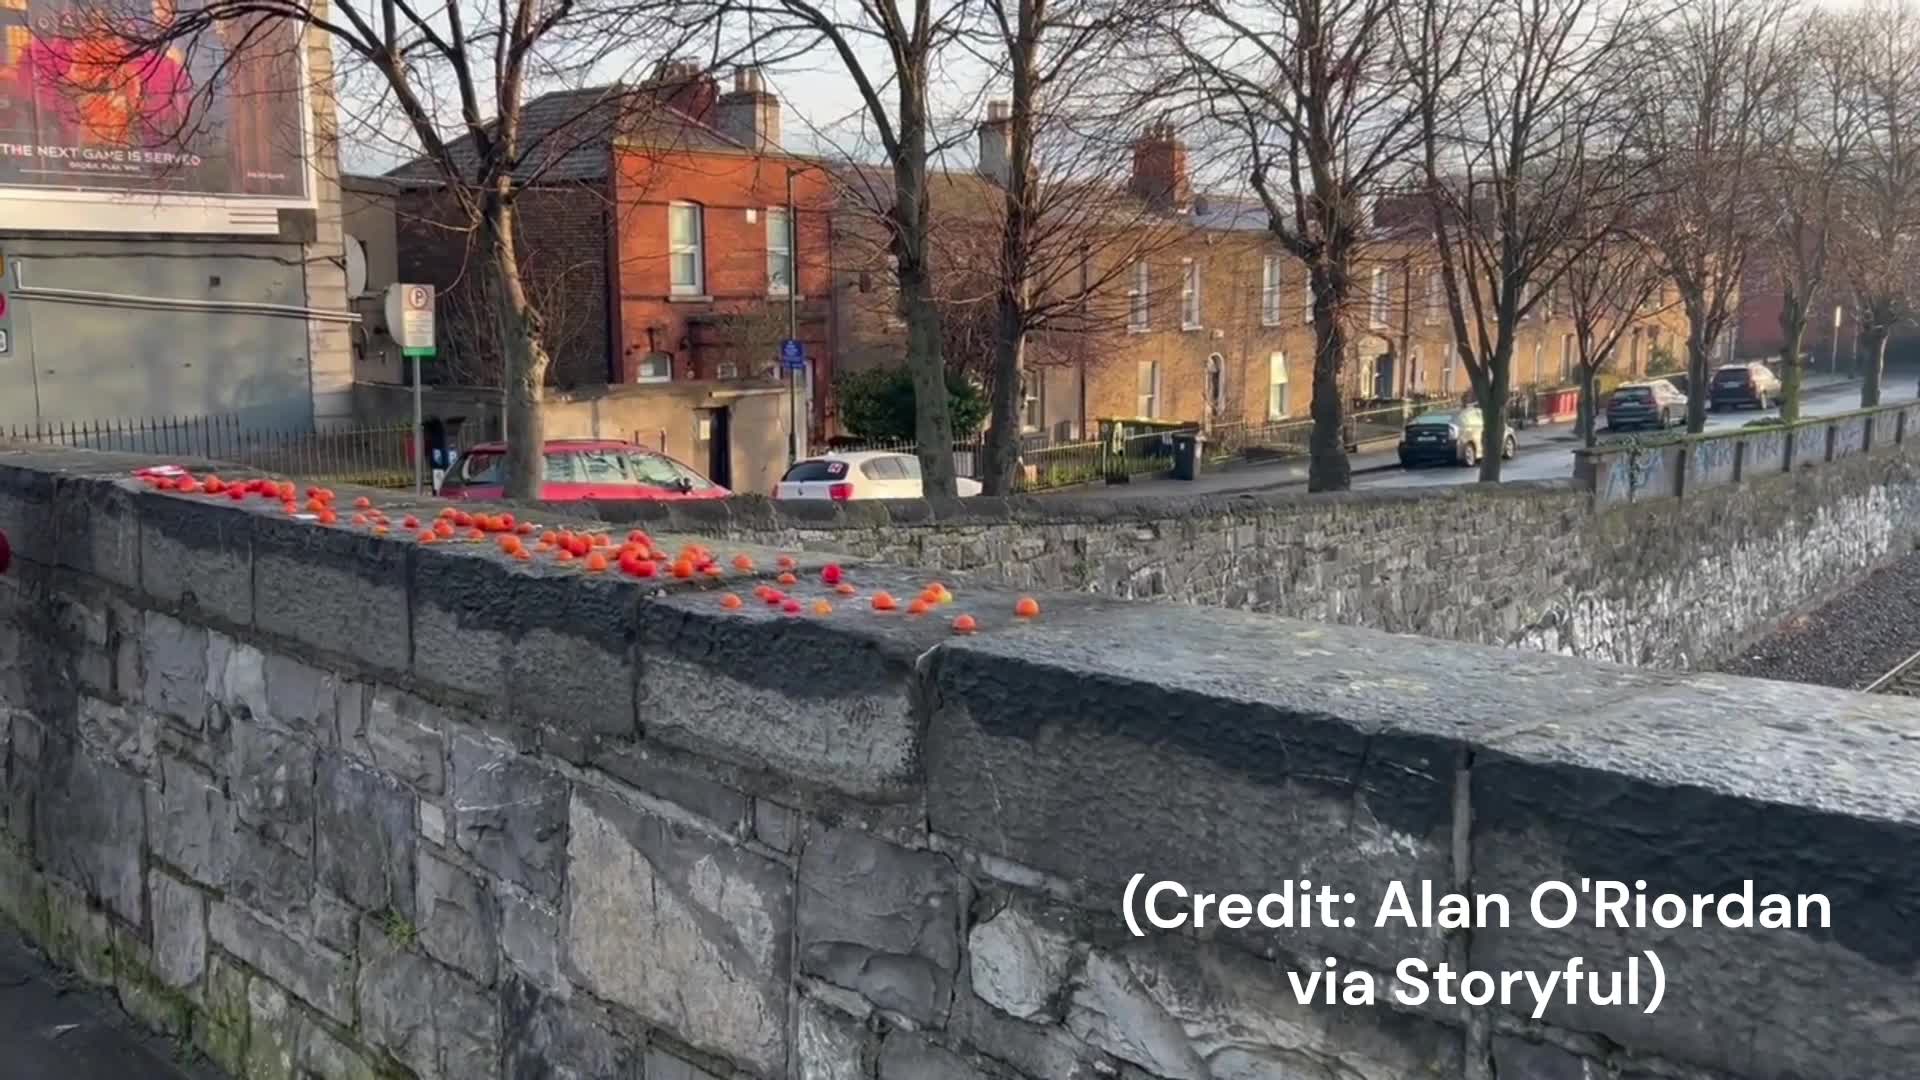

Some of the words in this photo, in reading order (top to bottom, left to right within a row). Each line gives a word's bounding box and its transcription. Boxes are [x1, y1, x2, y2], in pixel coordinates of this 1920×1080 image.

[0, 143, 32, 157] THE
[37, 145, 79, 159] NEXT
[82, 148, 124, 161] GAME
[127, 151, 141, 162] IS
